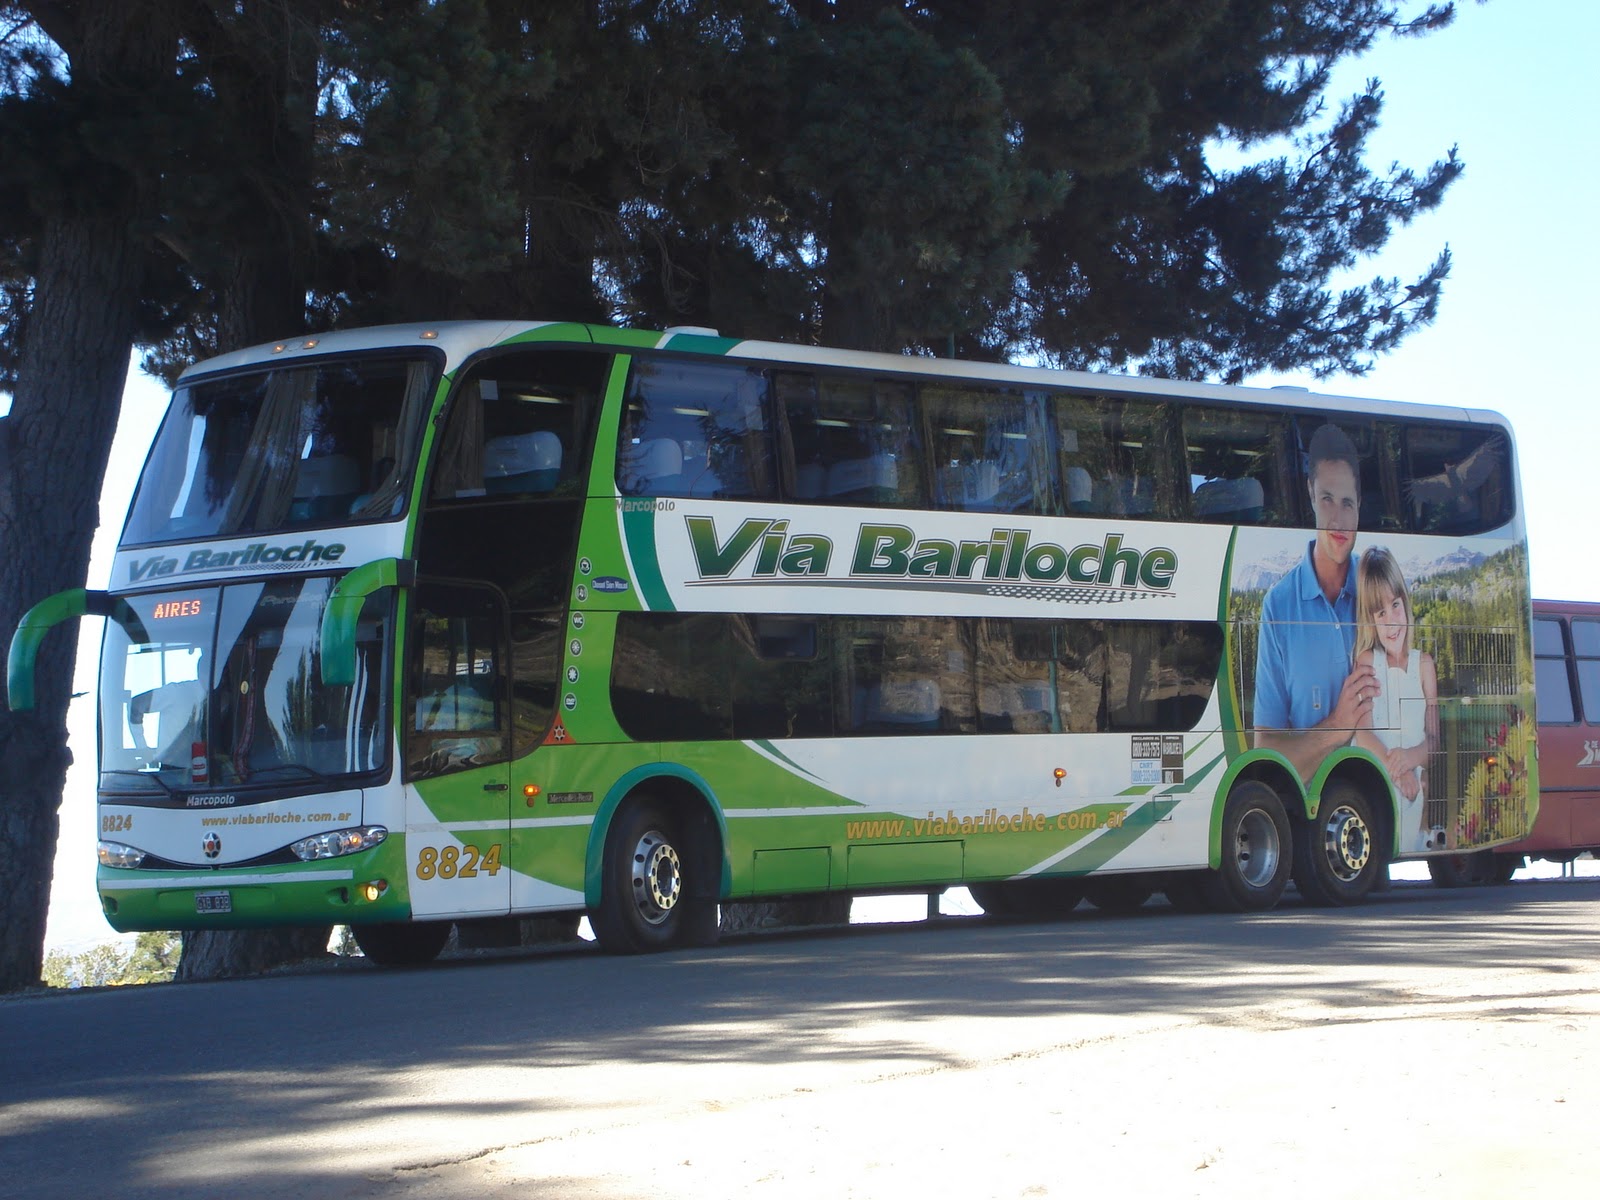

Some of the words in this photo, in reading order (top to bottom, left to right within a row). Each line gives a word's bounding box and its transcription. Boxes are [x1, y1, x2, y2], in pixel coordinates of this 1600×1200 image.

[616, 499, 676, 512] Marcopolo
[129, 555, 177, 583] Via
[184, 540, 346, 568] Bariloche
[684, 515, 834, 579] Via
[848, 522, 1179, 590] Bariloche
[153, 600, 201, 619] AIRES
[186, 793, 235, 806] Marcopolo
[102, 814, 132, 832] 8824
[201, 811, 351, 827] www.viabariloche.com.ar
[846, 808, 1128, 840] www.viabariloche.com.ar
[416, 844, 503, 880] 8824
